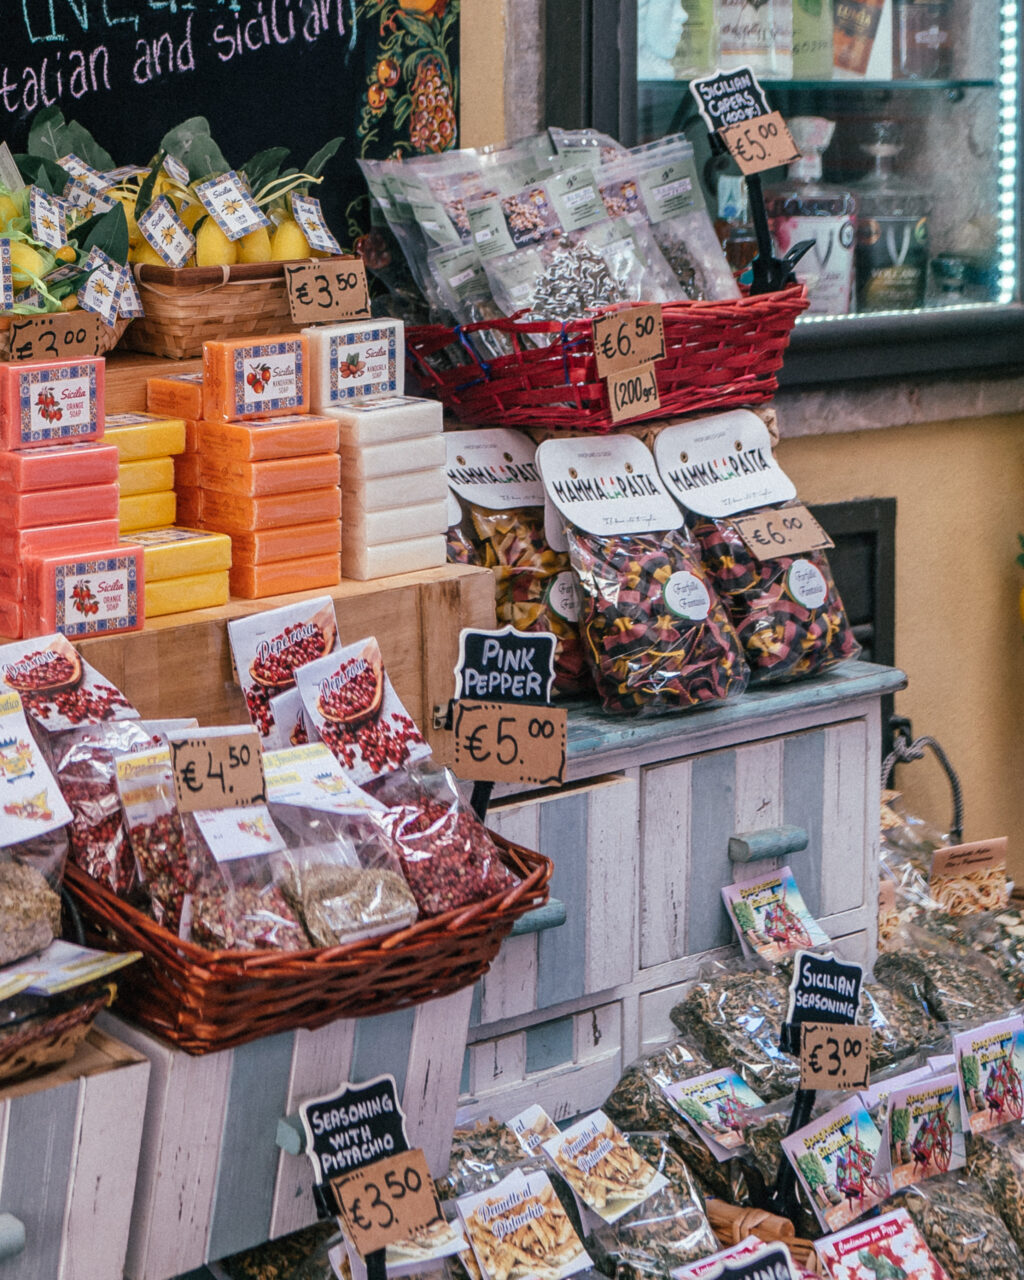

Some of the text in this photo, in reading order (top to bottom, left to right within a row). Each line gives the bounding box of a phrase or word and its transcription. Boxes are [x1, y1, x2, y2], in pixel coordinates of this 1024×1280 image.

[132, 11, 196, 87] and
[699, 73, 753, 101] SICILIAN
[707, 90, 757, 118] CAPERS
[734, 121, 779, 163] €5.00
[295, 271, 358, 309] €3.50
[599, 312, 656, 359] €6.50
[364, 346, 387, 360] Sicilia
[271, 365, 295, 379] Sicilia
[371, 371, 383, 380] SOAP
[60, 385, 86, 401] Sicilia
[278, 386, 289, 395] SOAP
[66, 401, 84, 411] ORANGE
[69, 409, 82, 419] SOAP
[96, 578, 125, 594] Sicilia
[102, 594, 122, 604] ORANGE
[105, 603, 119, 612] SOAP
[482, 638, 536, 671] PINK
[464, 668, 543, 698] PEPPER
[464, 716, 556, 766] €5.00
[179, 744, 252, 794] €4.50
[802, 962, 856, 998] SICILIAN
[795, 990, 855, 1019] SEASONING
[808, 1038, 863, 1077] €3.00
[312, 1093, 394, 1136] SEASONING
[329, 1123, 373, 1151] WITH
[320, 1132, 395, 1174] PISTACHIO
[349, 1166, 423, 1230] €3.50
[477, 1182, 533, 1223] Pennette al
[492, 1202, 546, 1242] Pistacchio
